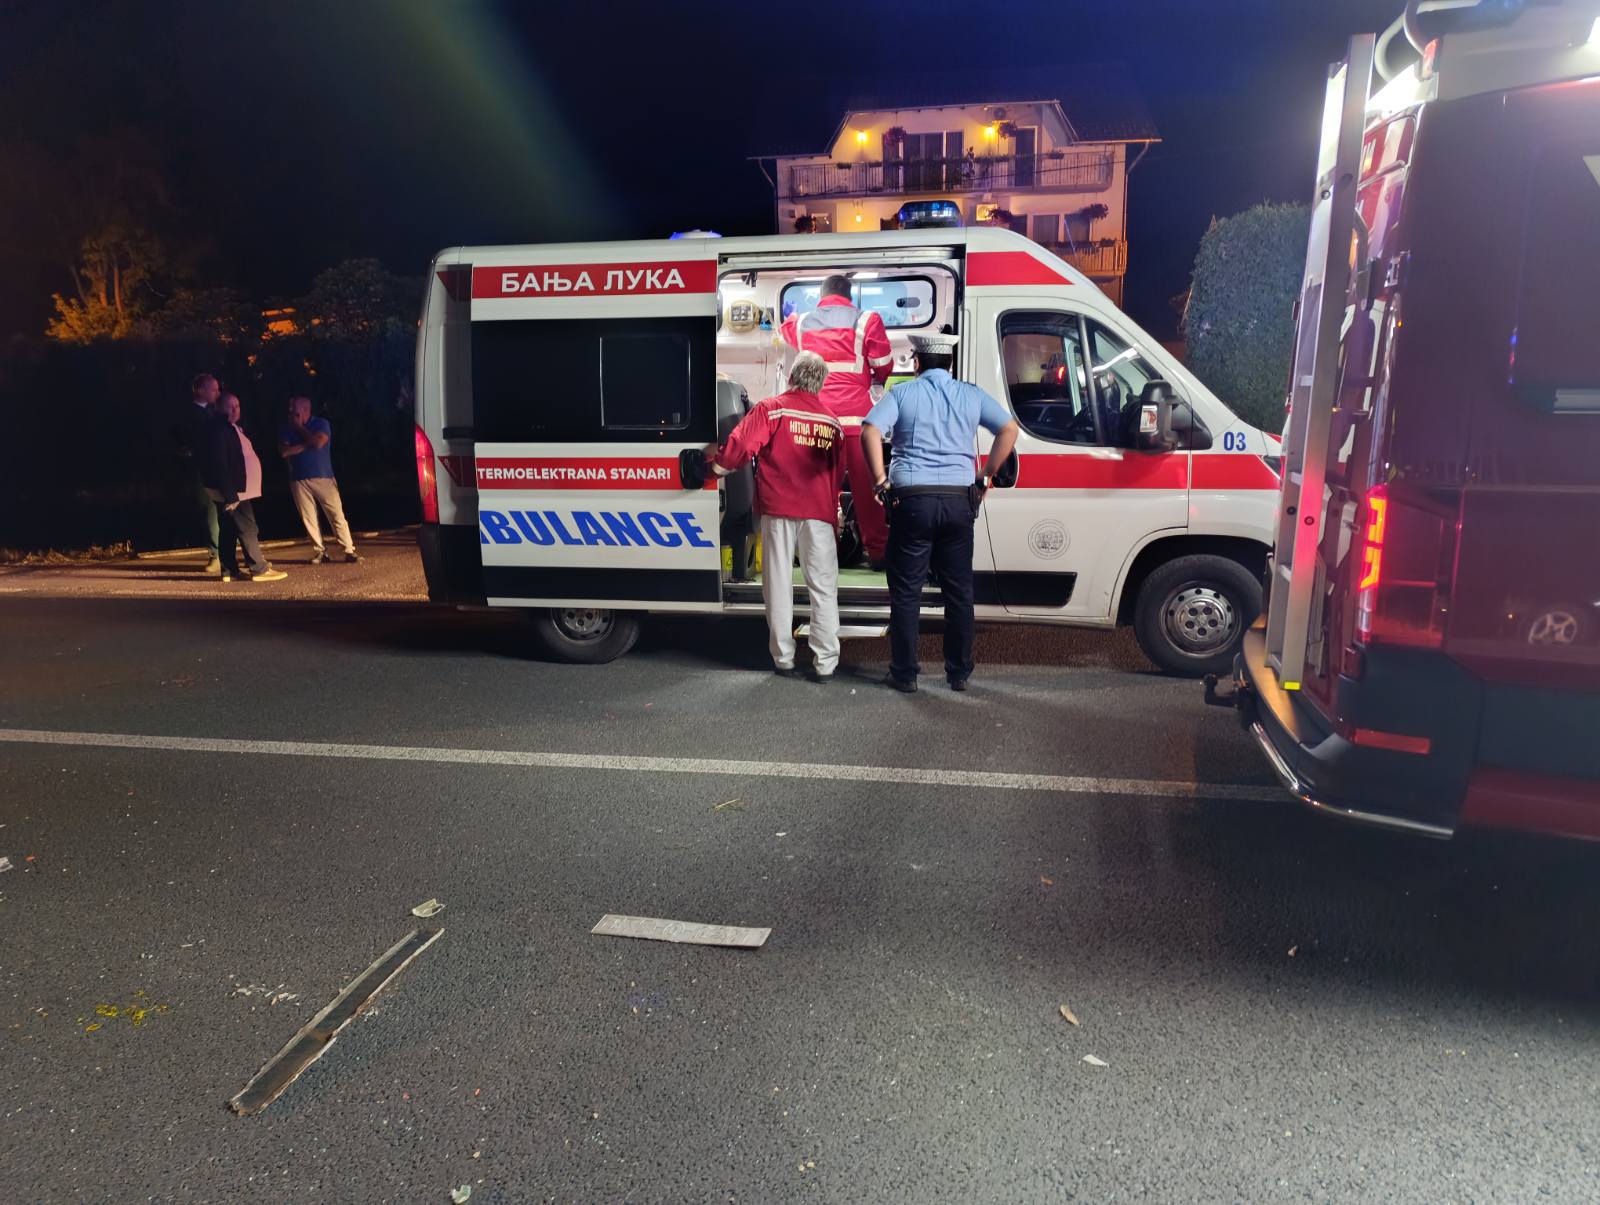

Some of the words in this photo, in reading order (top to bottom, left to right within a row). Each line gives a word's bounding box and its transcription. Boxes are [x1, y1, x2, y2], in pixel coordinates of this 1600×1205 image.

[502, 271, 594, 292] БАЊА
[604, 268, 685, 289] ЛУКА
[790, 421, 810, 435] HITNA
[1224, 432, 1246, 451] 03
[478, 468, 606, 480] TERMOELEKTRANA
[610, 468, 671, 479] STANARI
[480, 510, 715, 547] BULANCE
